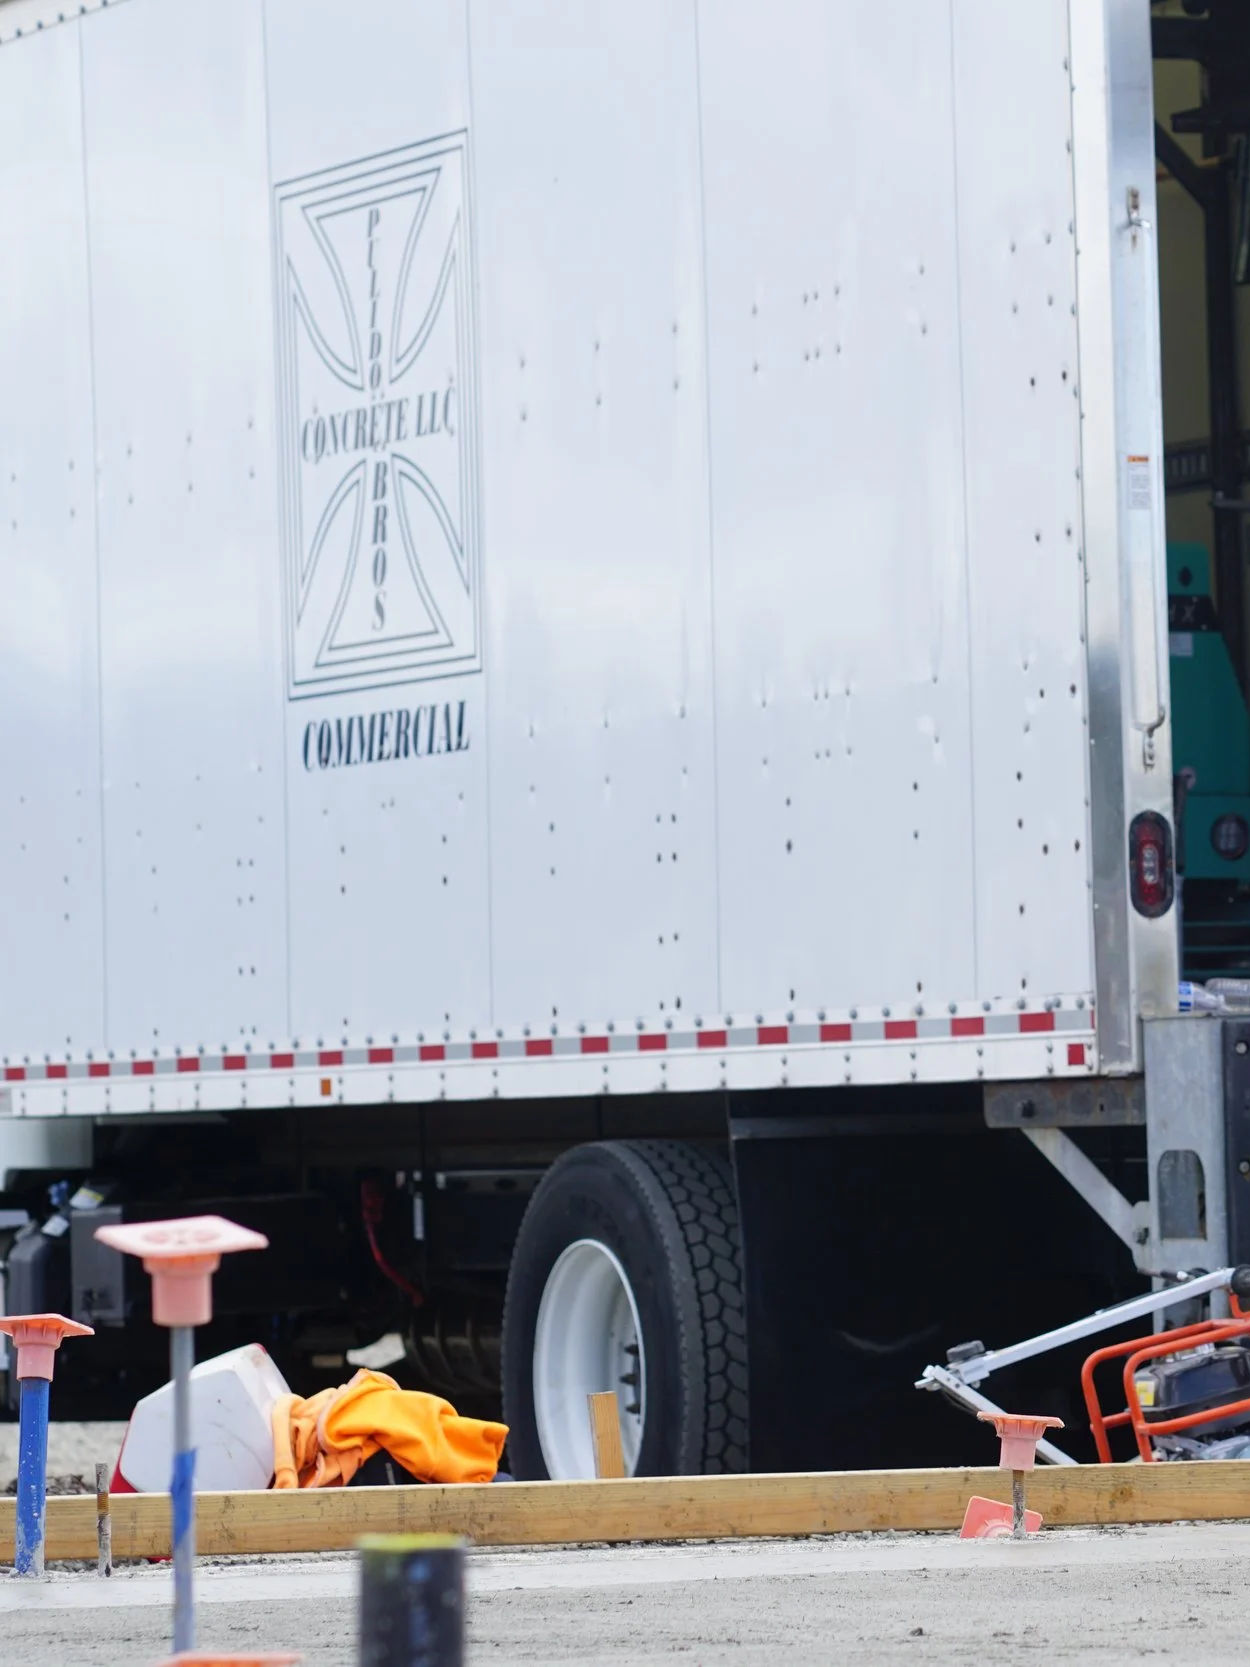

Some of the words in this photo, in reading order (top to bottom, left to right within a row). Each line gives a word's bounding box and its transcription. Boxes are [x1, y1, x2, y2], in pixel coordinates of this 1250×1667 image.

[302, 397, 409, 462] CONCRETE
[415, 387, 455, 437] LLC
[372, 461, 388, 631] BROS
[303, 700, 469, 772] COMMERCIAL
